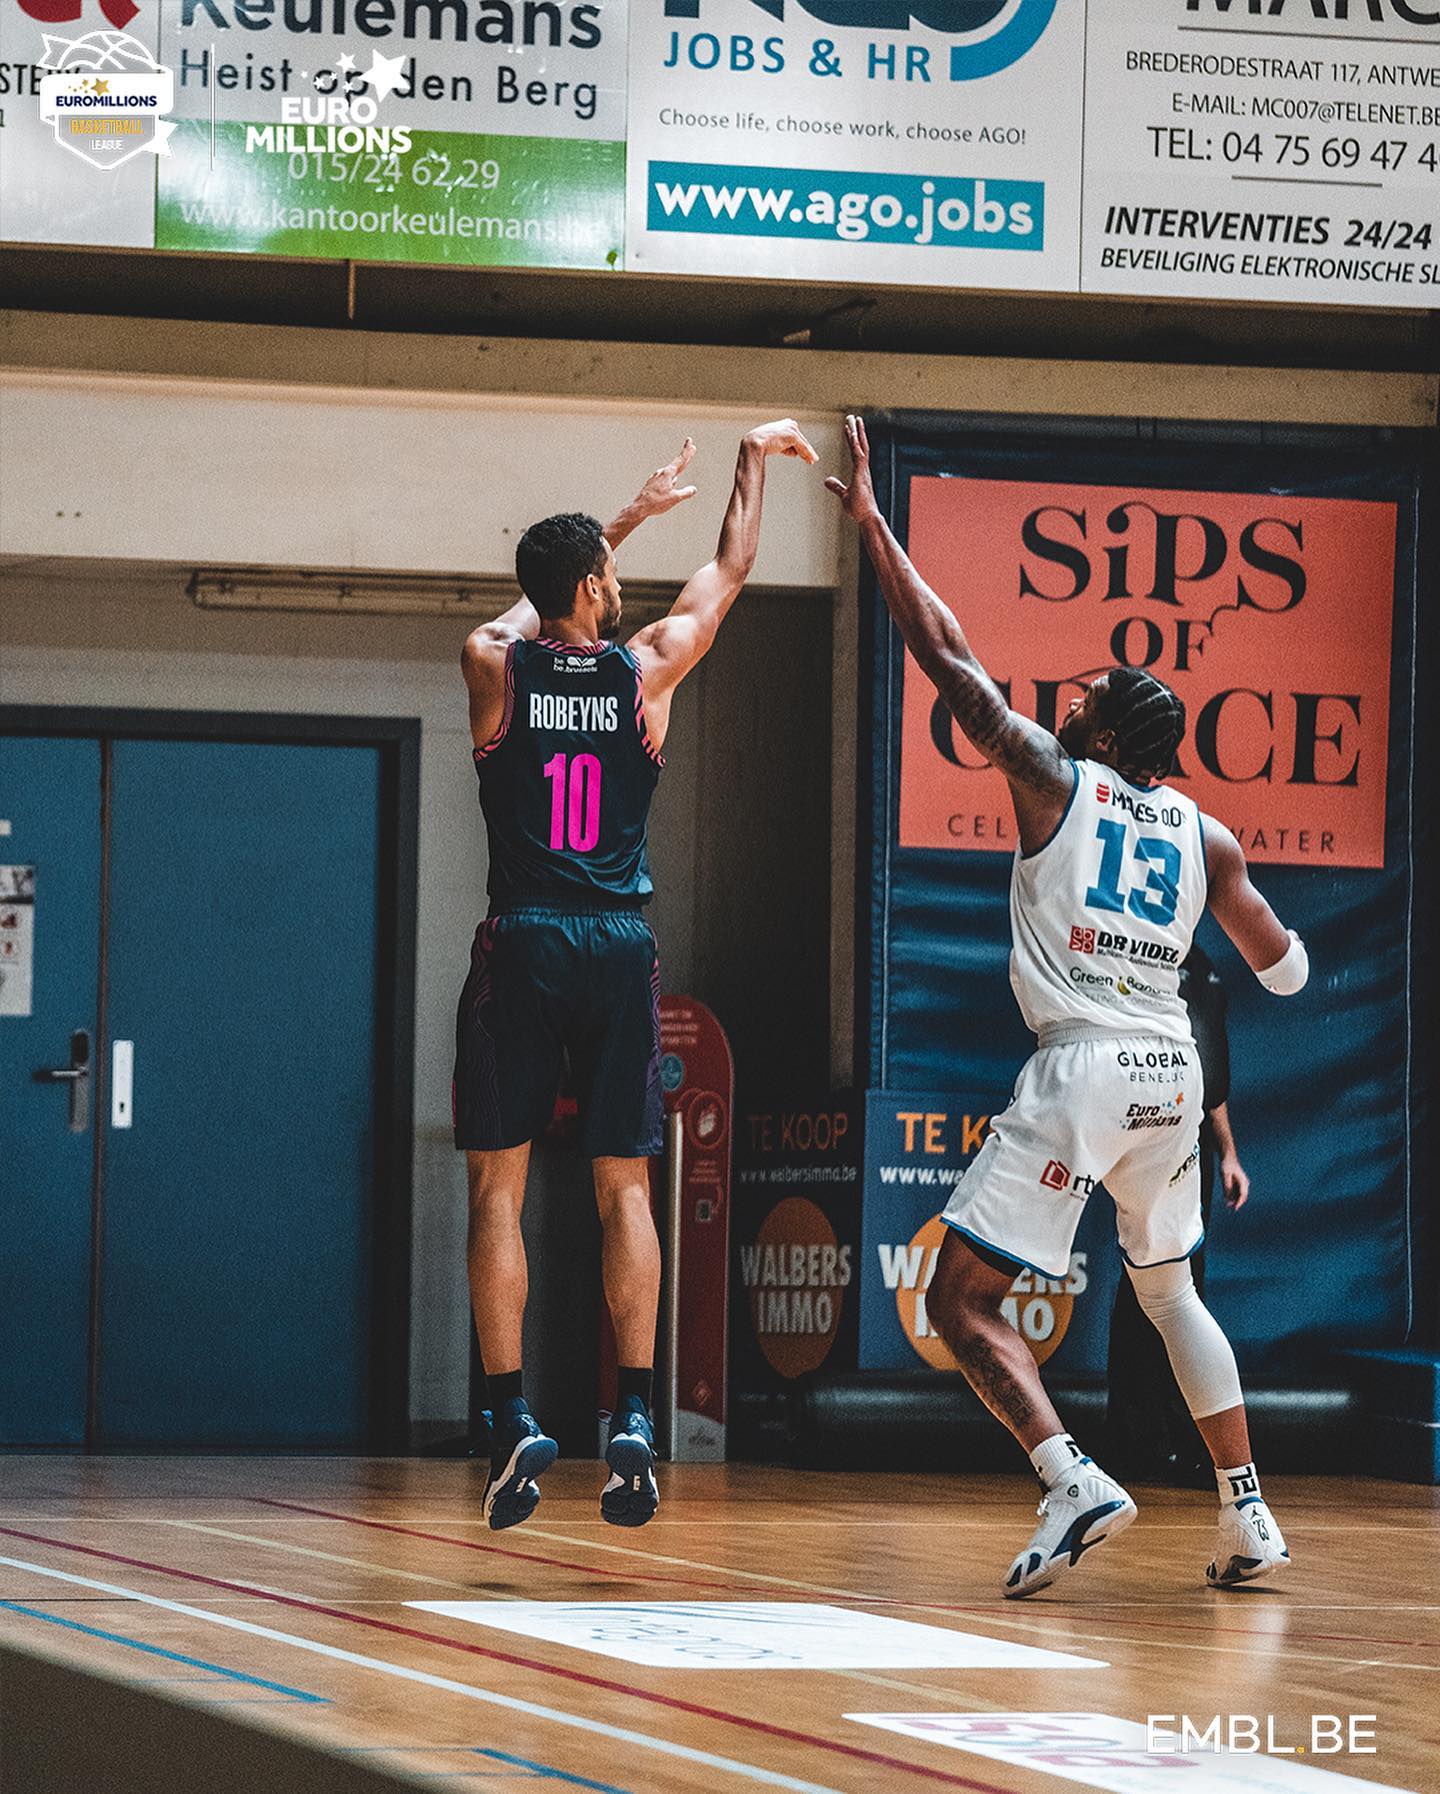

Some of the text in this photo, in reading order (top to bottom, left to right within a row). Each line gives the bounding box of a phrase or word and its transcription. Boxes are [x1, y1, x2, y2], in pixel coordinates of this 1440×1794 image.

[664, 31, 931, 82] JOBS & HR
[1126, 51, 1324, 81] BREDERODESTRAAT
[1331, 63, 1361, 85] 117,
[181, 49, 597, 120] Heist op den Berg
[659, 108, 1027, 145] Choose life, choose work, choose AGO!
[1172, 93, 1440, 126] E-MAIL: MC007@TELENET.BE
[288, 152, 403, 185] 015/24
[1147, 126, 1440, 172] TEL: 04 75 69 47 4
[655, 180, 1034, 243] www.ago.jobs
[1104, 206, 1432, 250] INTERVENTIES 24/24
[1100, 248, 1235, 274] BEVEILIGING
[1240, 255, 1415, 284] ELEKTRONISCHE
[1110, 616, 1214, 672] OF
[529, 693, 619, 732] ROBEYNS
[544, 753, 602, 852] 10
[1085, 818, 1182, 927] 13
[1069, 966, 1114, 987] Green
[1117, 1051, 1188, 1069] GLOBAL
[1126, 1103, 1161, 1117] Euro
[781, 1111, 849, 1152] KOOP
[896, 1112, 947, 1154] TE
[740, 1244, 852, 1287] WALBERS
[757, 1290, 833, 1334] IMMO
